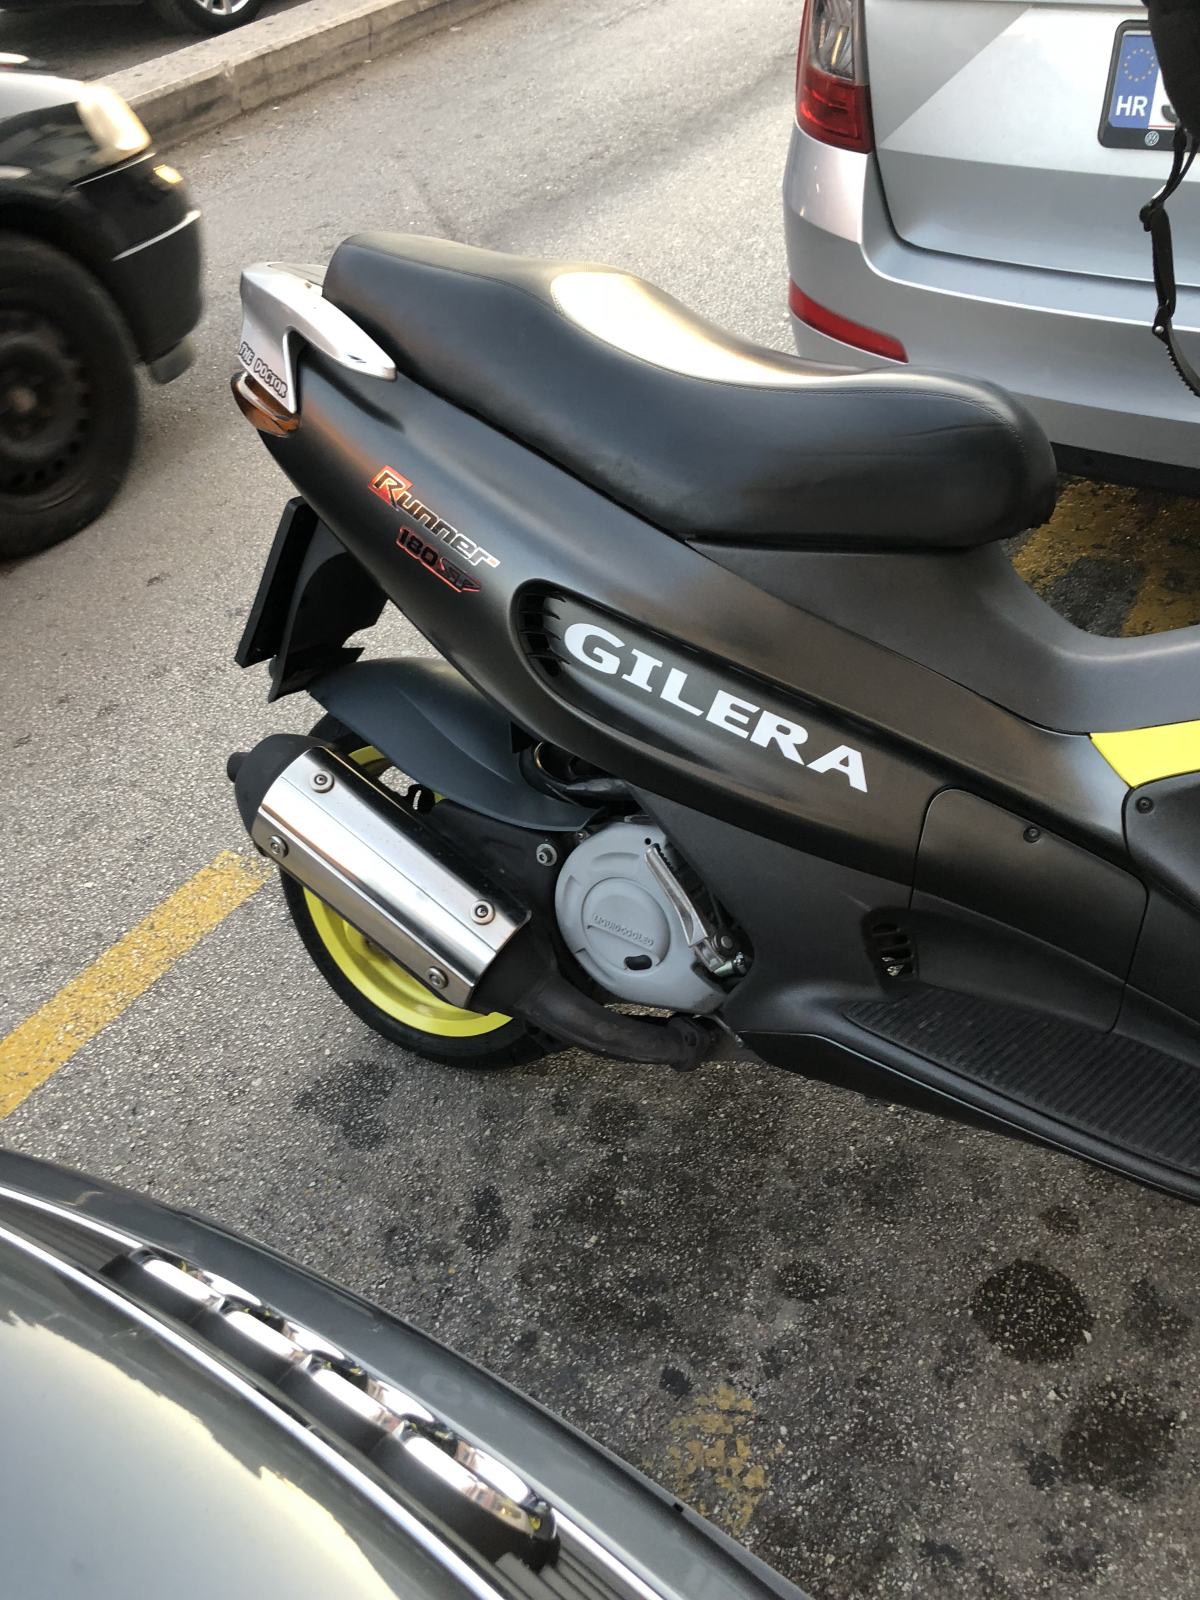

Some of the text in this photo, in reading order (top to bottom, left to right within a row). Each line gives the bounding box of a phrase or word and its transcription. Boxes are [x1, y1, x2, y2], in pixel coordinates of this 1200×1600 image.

[1115, 95, 1148, 117] HR
[239, 341, 288, 399] THE DOCTOR
[371, 468, 501, 569] Runner
[563, 622, 868, 793] GILERA
